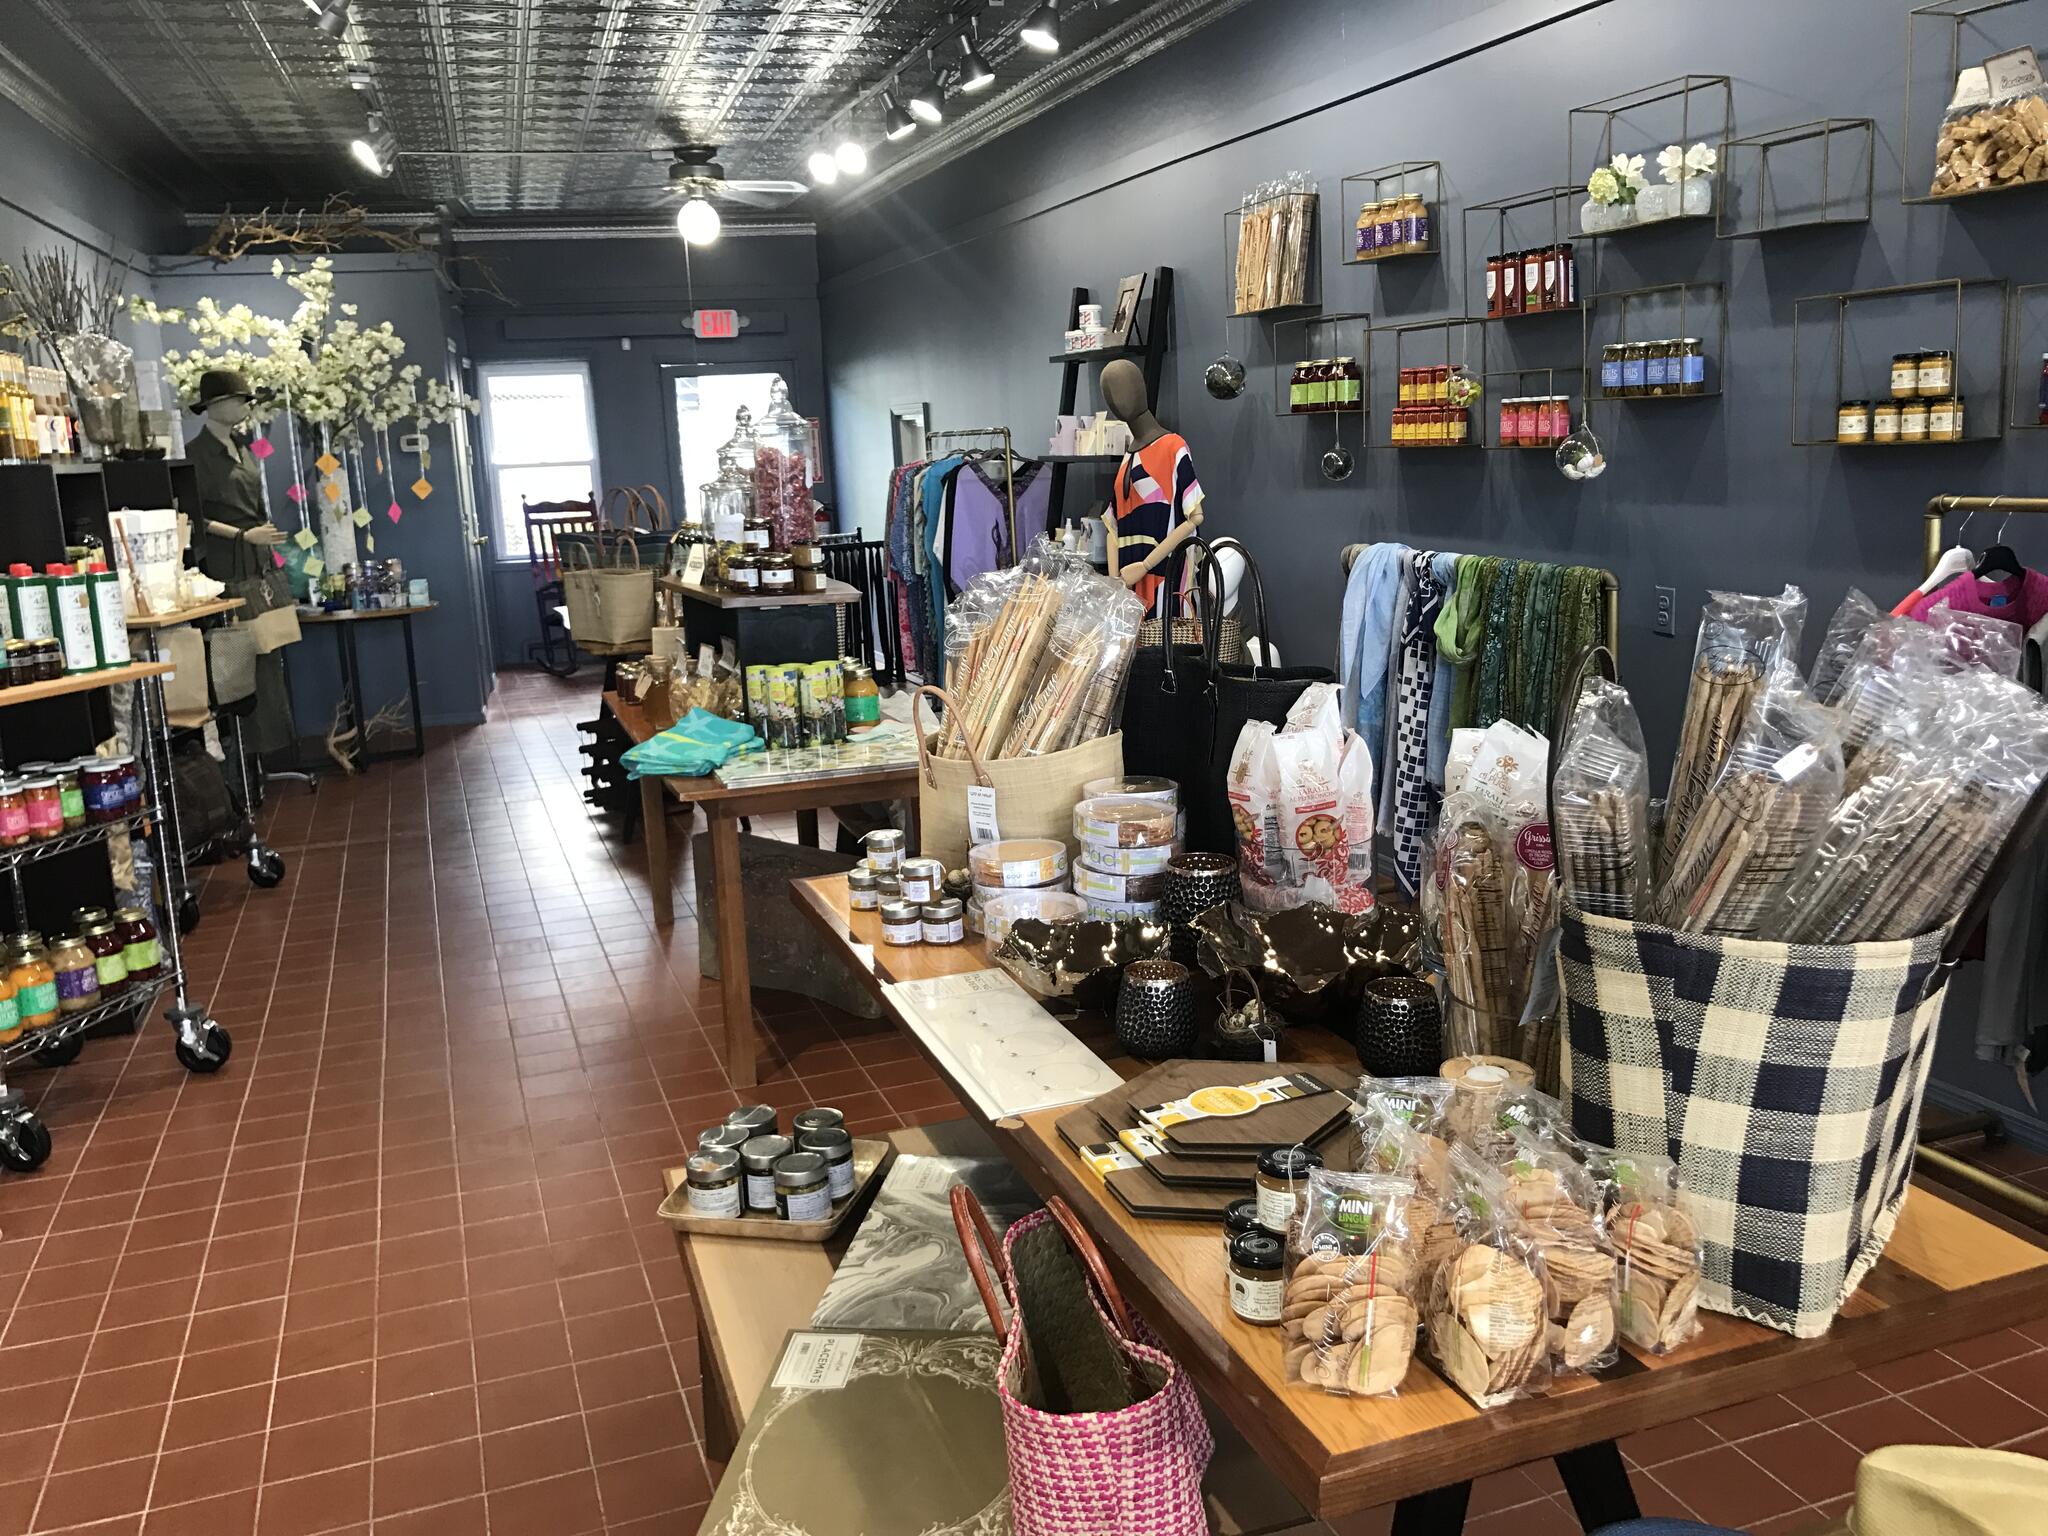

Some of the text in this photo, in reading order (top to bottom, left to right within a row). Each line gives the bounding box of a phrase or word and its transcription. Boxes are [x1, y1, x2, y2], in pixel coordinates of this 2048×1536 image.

[701, 311, 732, 336] EXIT
[1524, 830, 1551, 846] Grissi
[1339, 1199, 1374, 1216] MINI
[810, 1338, 835, 1384] PLACEMATS
